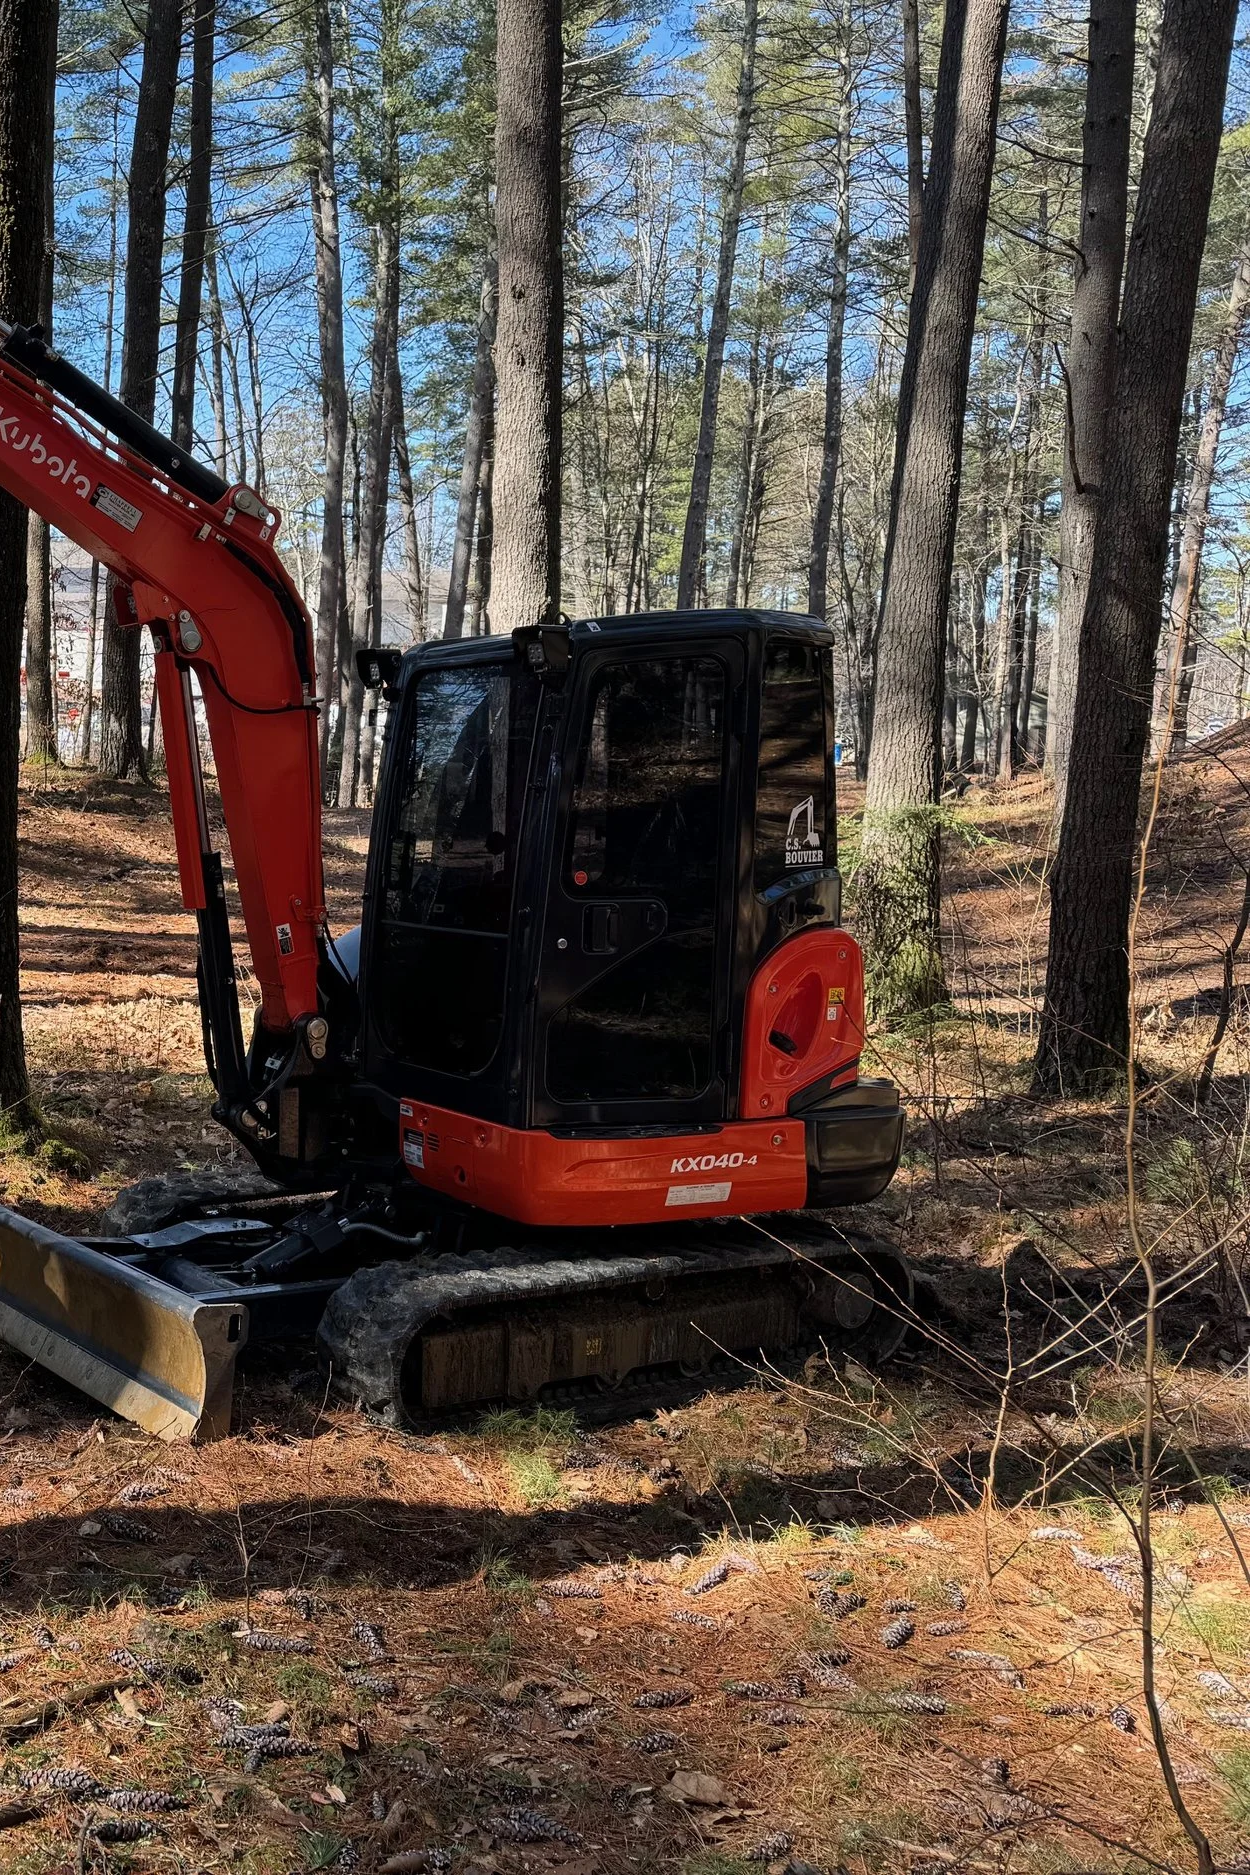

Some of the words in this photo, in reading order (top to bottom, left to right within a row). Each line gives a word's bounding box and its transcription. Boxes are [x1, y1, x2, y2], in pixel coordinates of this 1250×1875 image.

[785, 838, 801, 850] C.S.
[785, 850, 823, 864] BOUVIER
[670, 1152, 758, 1174] KX040-4
